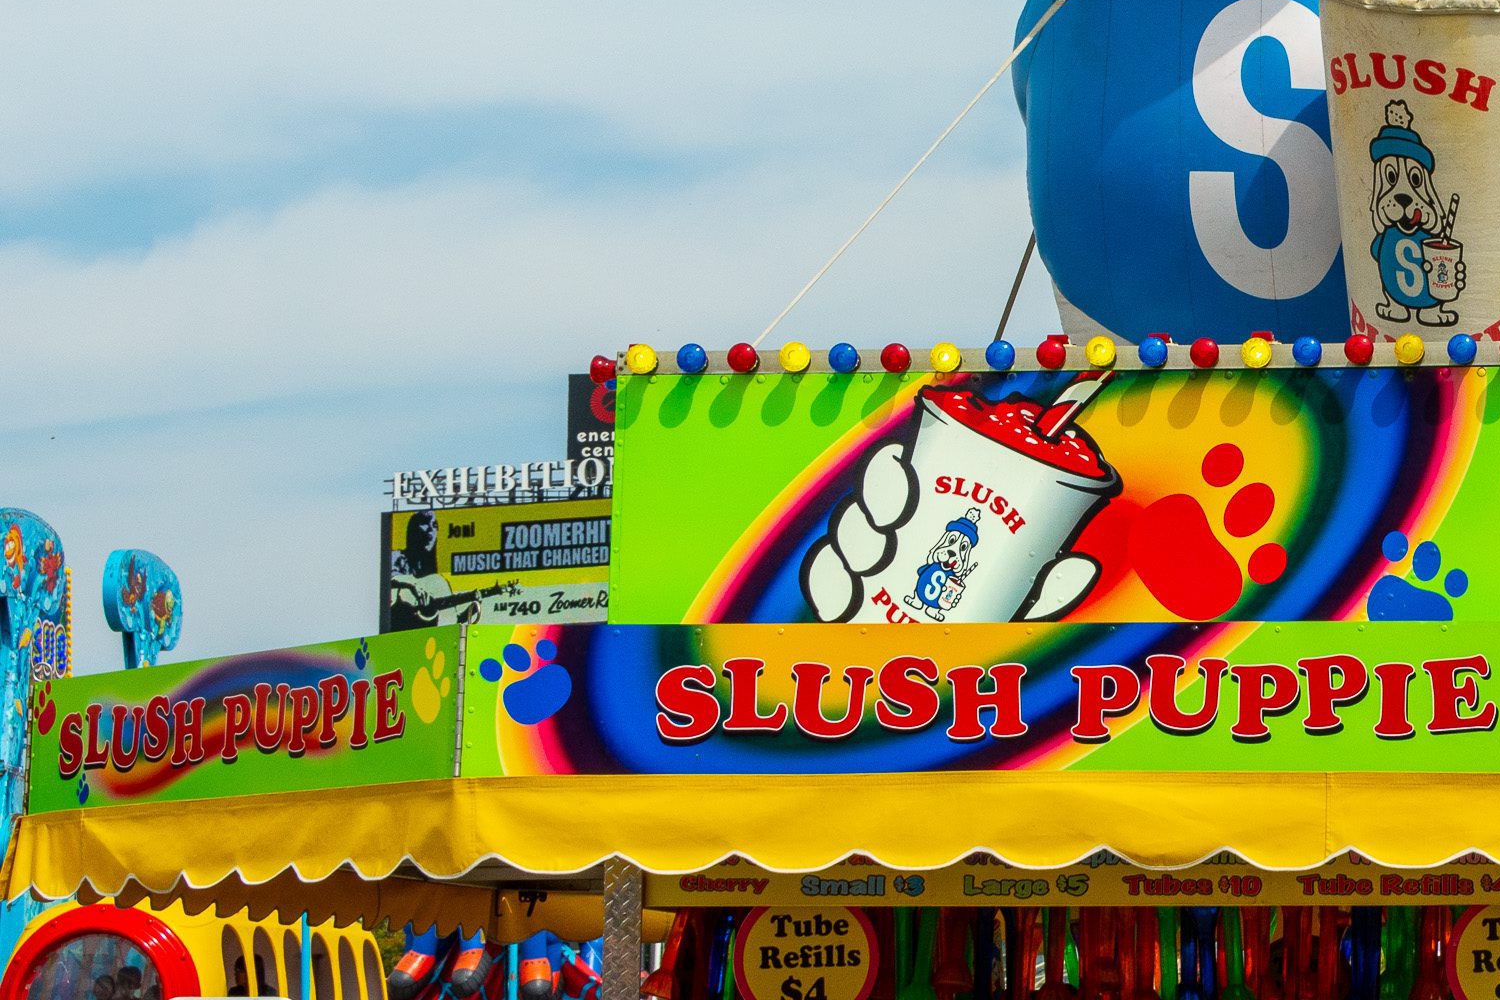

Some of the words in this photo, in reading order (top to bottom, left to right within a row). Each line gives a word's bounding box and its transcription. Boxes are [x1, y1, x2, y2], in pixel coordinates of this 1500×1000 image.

[1330, 53, 1497, 112] SLUSH
[1395, 238, 1424, 297] S
[935, 475, 1027, 535] SLUSH
[504, 520, 611, 550] ZOOMERHI
[454, 552, 501, 573] MUSIC
[503, 550, 540, 570] THAT
[542, 546, 609, 567] CHANGED
[924, 570, 947, 600] S
[548, 591, 594, 614] Zoomer
[655, 656, 1029, 744] SLUSH
[1070, 654, 1498, 743] PUPPIE
[58, 695, 206, 778] SLUSH
[221, 668, 406, 763] PUPPIE
[680, 874, 769, 894] Cherry
[800, 875, 886, 896] Small
[893, 875, 925, 897] $3
[963, 875, 1050, 899] Large
[1056, 875, 1089, 897] $5
[1122, 874, 1214, 896] Tubes
[1218, 875, 1263, 897] $10
[1296, 874, 1373, 896] Tube
[1379, 874, 1474, 896] Refills
[770, 914, 849, 938] Tube
[759, 944, 861, 969] Refills
[781, 975, 828, 1000] $4
